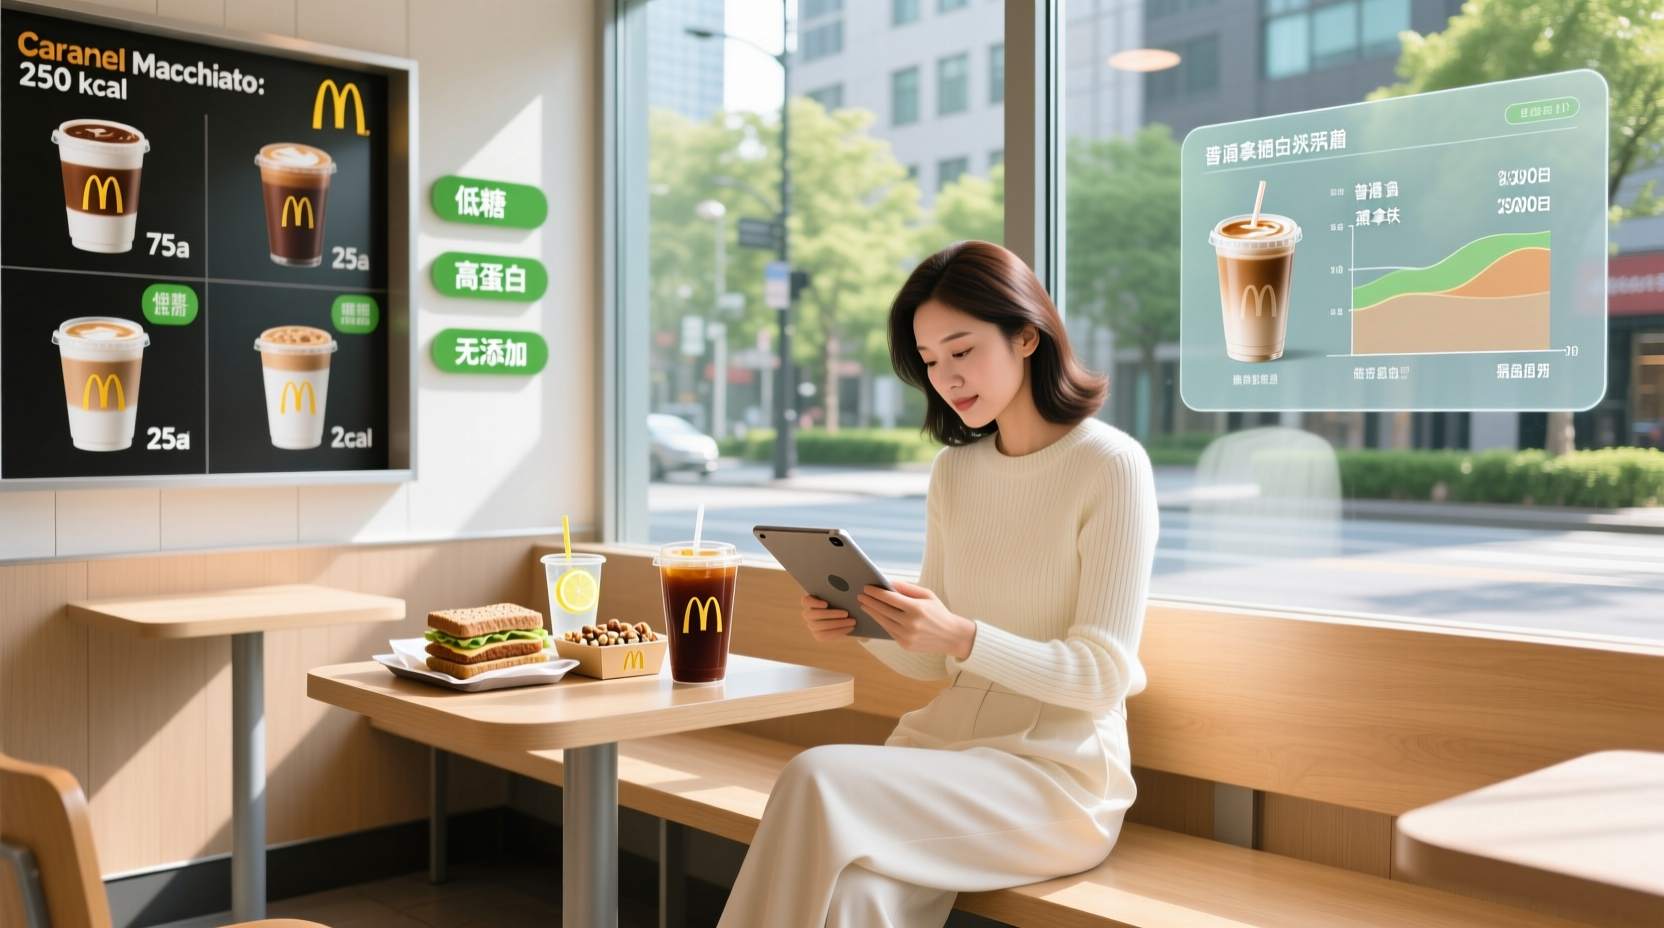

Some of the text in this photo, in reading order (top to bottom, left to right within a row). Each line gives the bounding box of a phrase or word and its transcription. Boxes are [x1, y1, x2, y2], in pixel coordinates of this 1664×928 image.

[17, 31, 265, 95] Caranel Macchiato:
[19, 62, 127, 100] 250 kcal
[455, 185, 507, 219] 低糖
[146, 232, 190, 258] 75a
[332, 246, 369, 270] 25a
[454, 260, 526, 293] 高蛋白
[455, 337, 527, 367] 无添加
[330, 426, 372, 448] 2cal
